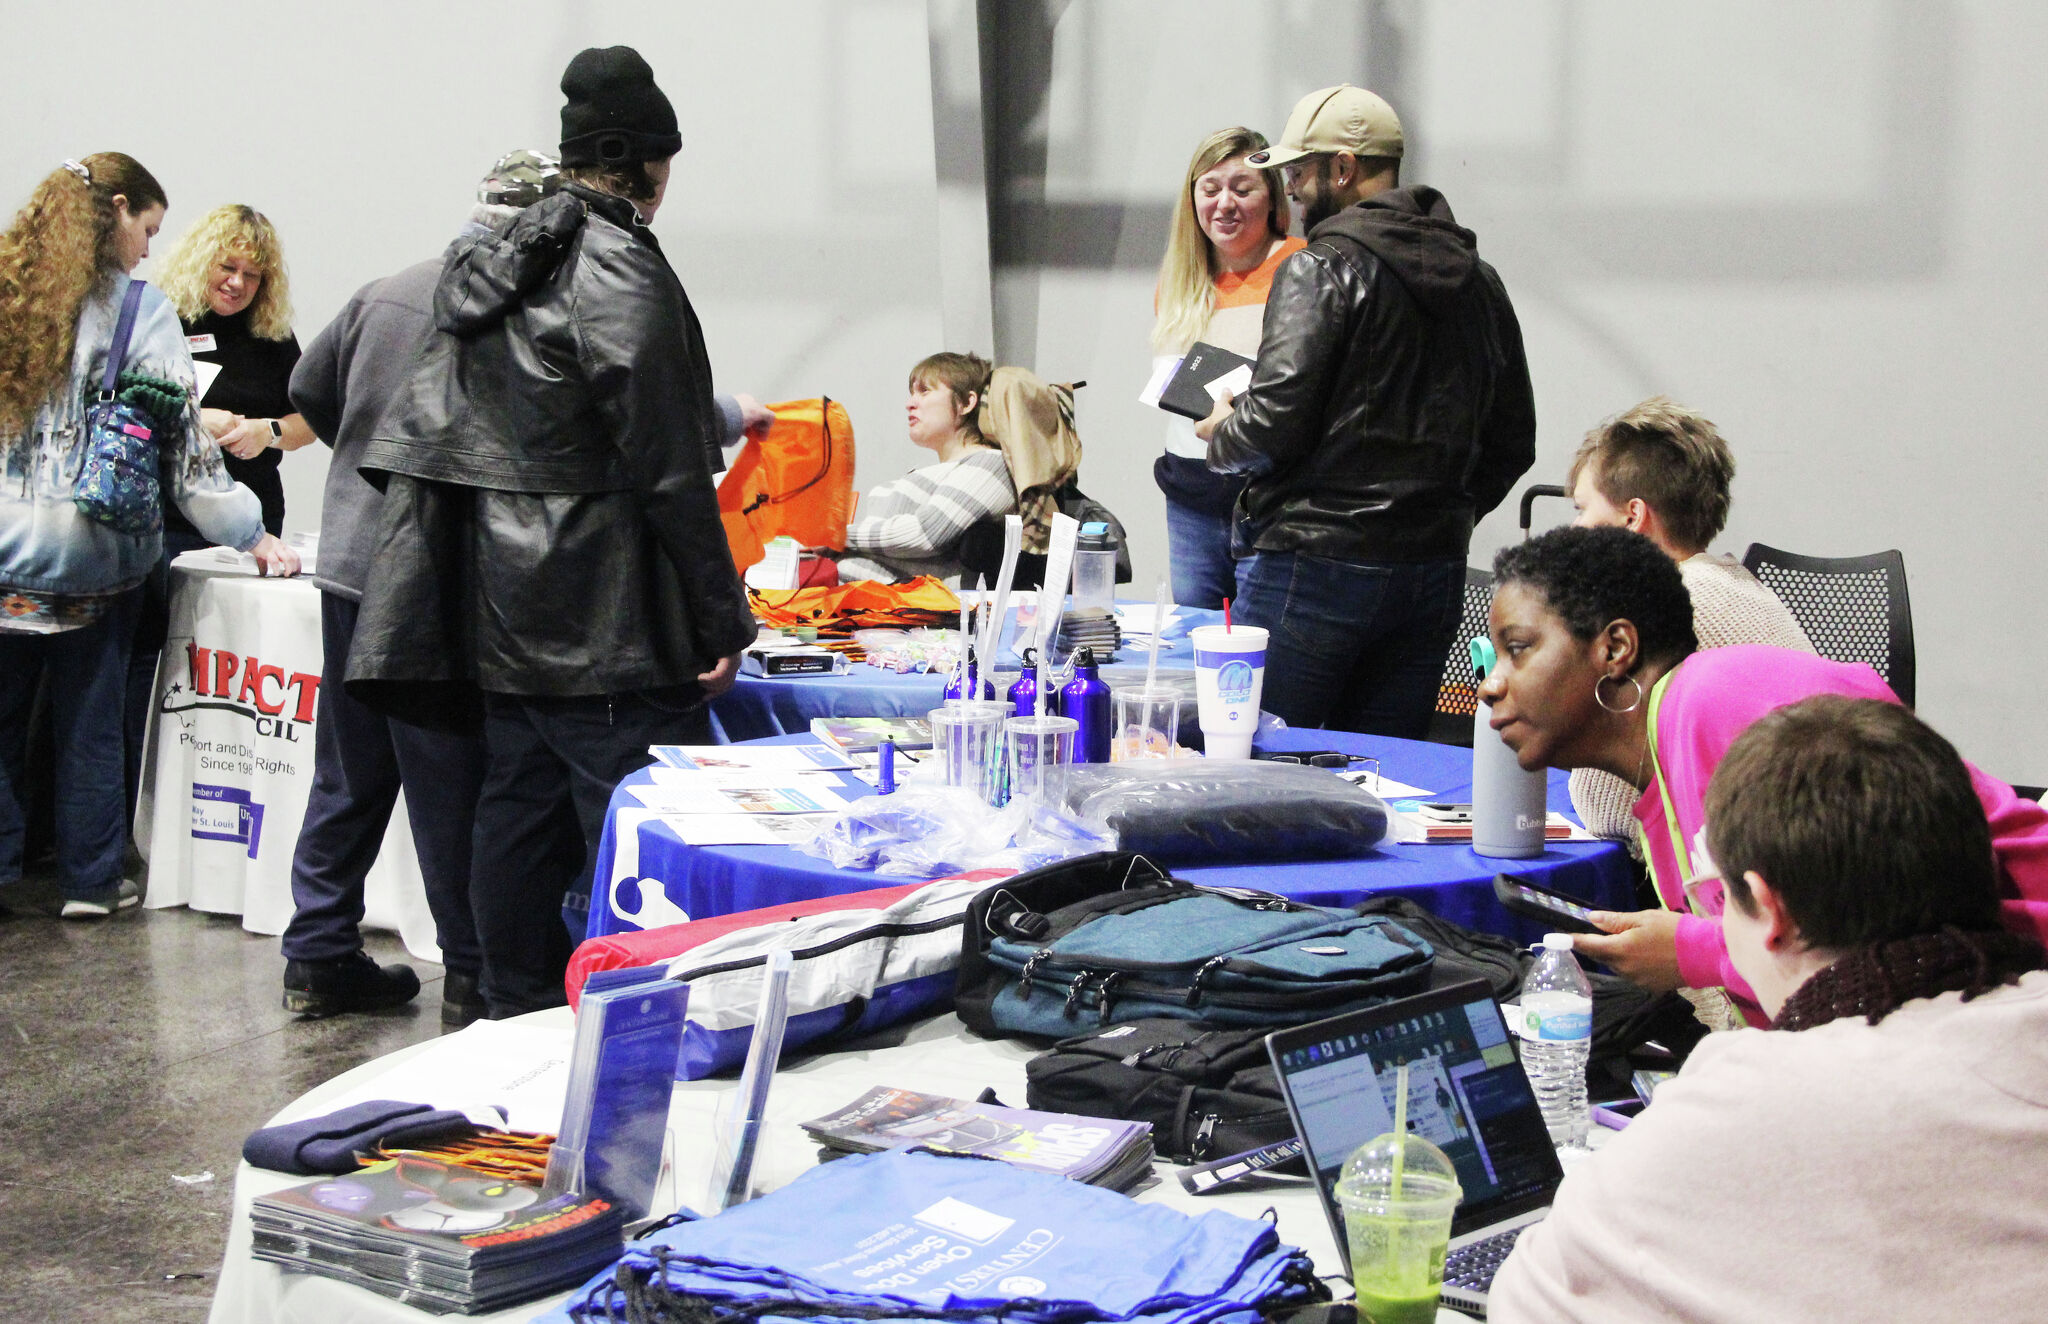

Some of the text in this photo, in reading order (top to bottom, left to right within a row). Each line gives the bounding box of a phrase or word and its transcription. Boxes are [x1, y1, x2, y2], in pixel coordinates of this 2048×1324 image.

[256, 717, 300, 743] CIL
[200, 756, 235, 772] Since
[216, 743, 237, 755] and
[239, 744, 254, 759] Dis
[255, 756, 296, 776] Rights
[215, 789, 224, 798] of
[200, 817, 211, 827] St.
[213, 818, 235, 829] Louis
[852, 1235, 948, 1278] Services
[909, 1245, 973, 1276] Open
[920, 1228, 1054, 1297] CENTERSTO
